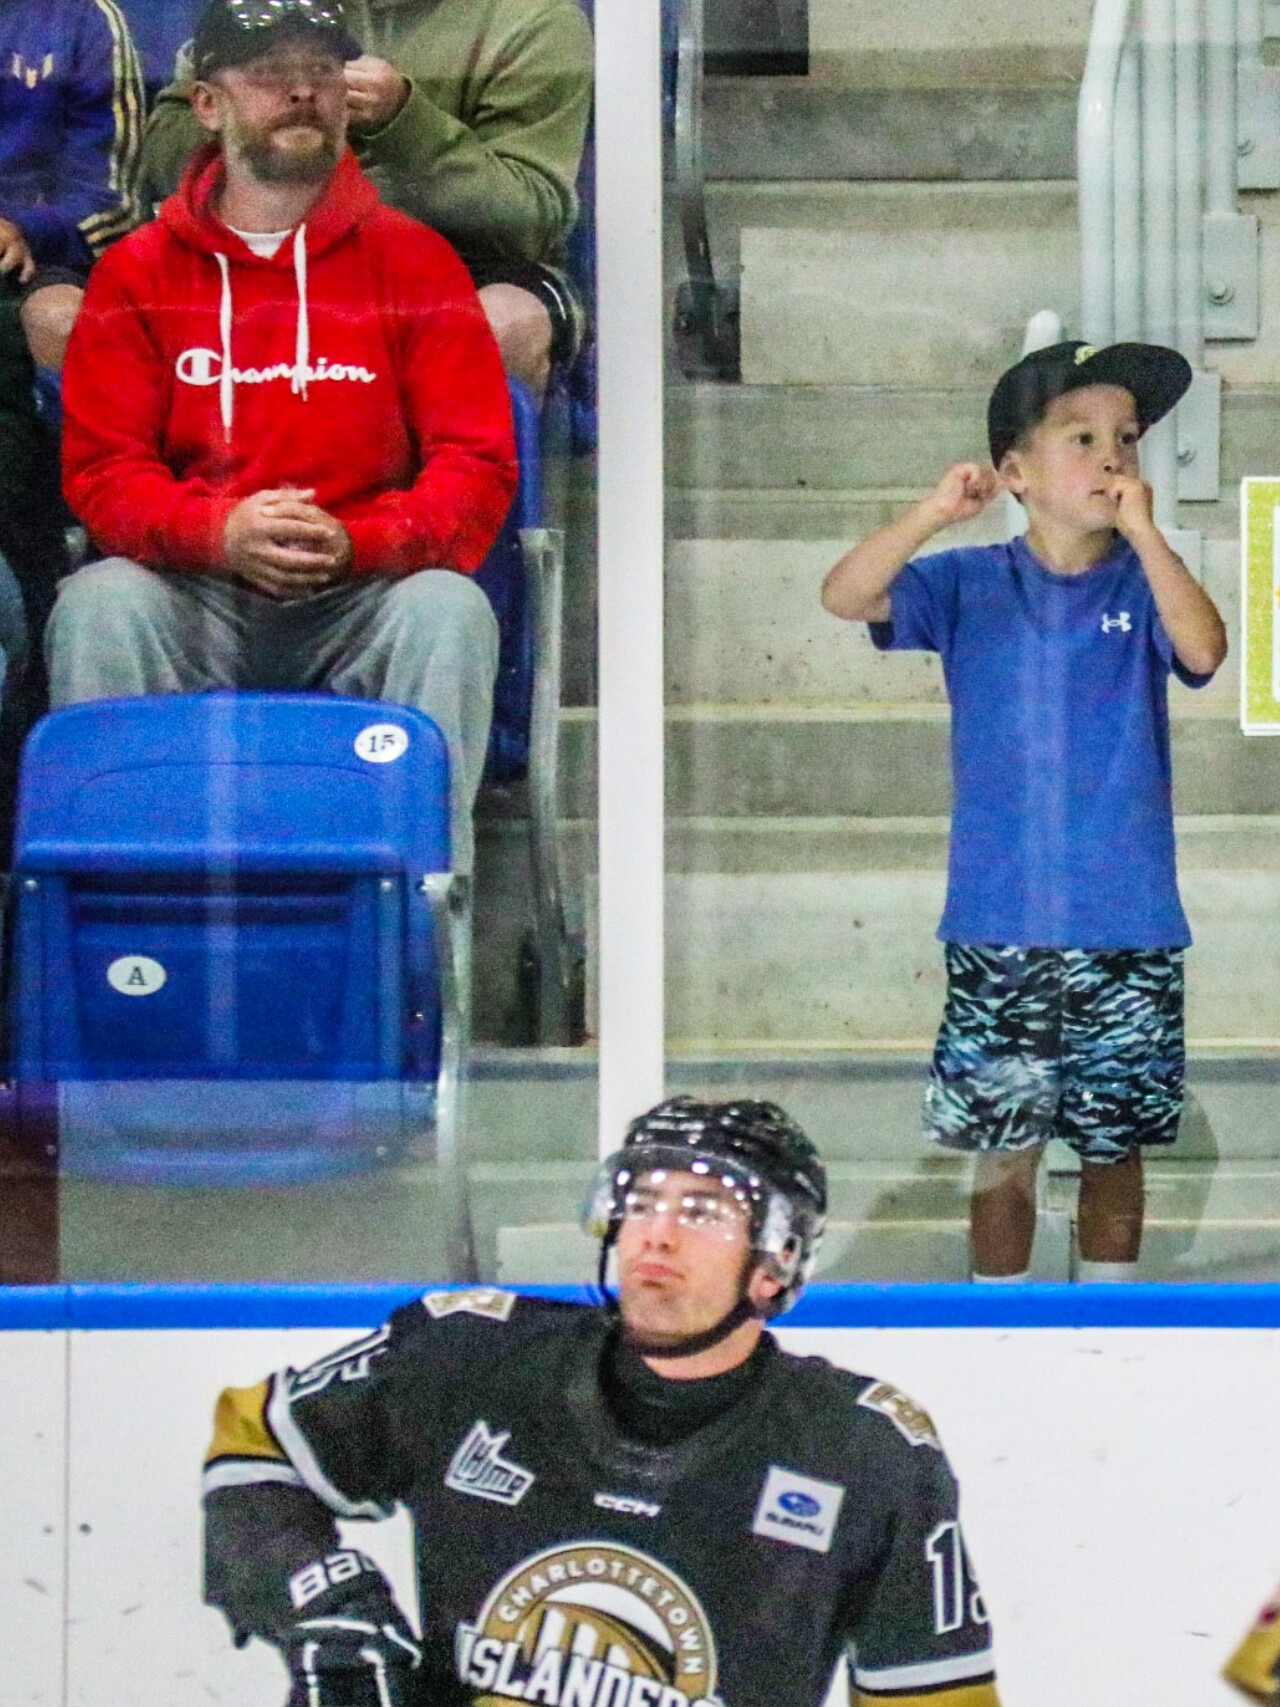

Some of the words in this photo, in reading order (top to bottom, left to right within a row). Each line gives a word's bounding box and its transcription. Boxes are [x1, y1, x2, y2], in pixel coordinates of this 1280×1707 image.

[367, 733, 395, 753] 15
[126, 965, 147, 986] A
[593, 1493, 662, 1517] CCM
[497, 1557, 703, 1674] CHARLOTTETOWN
